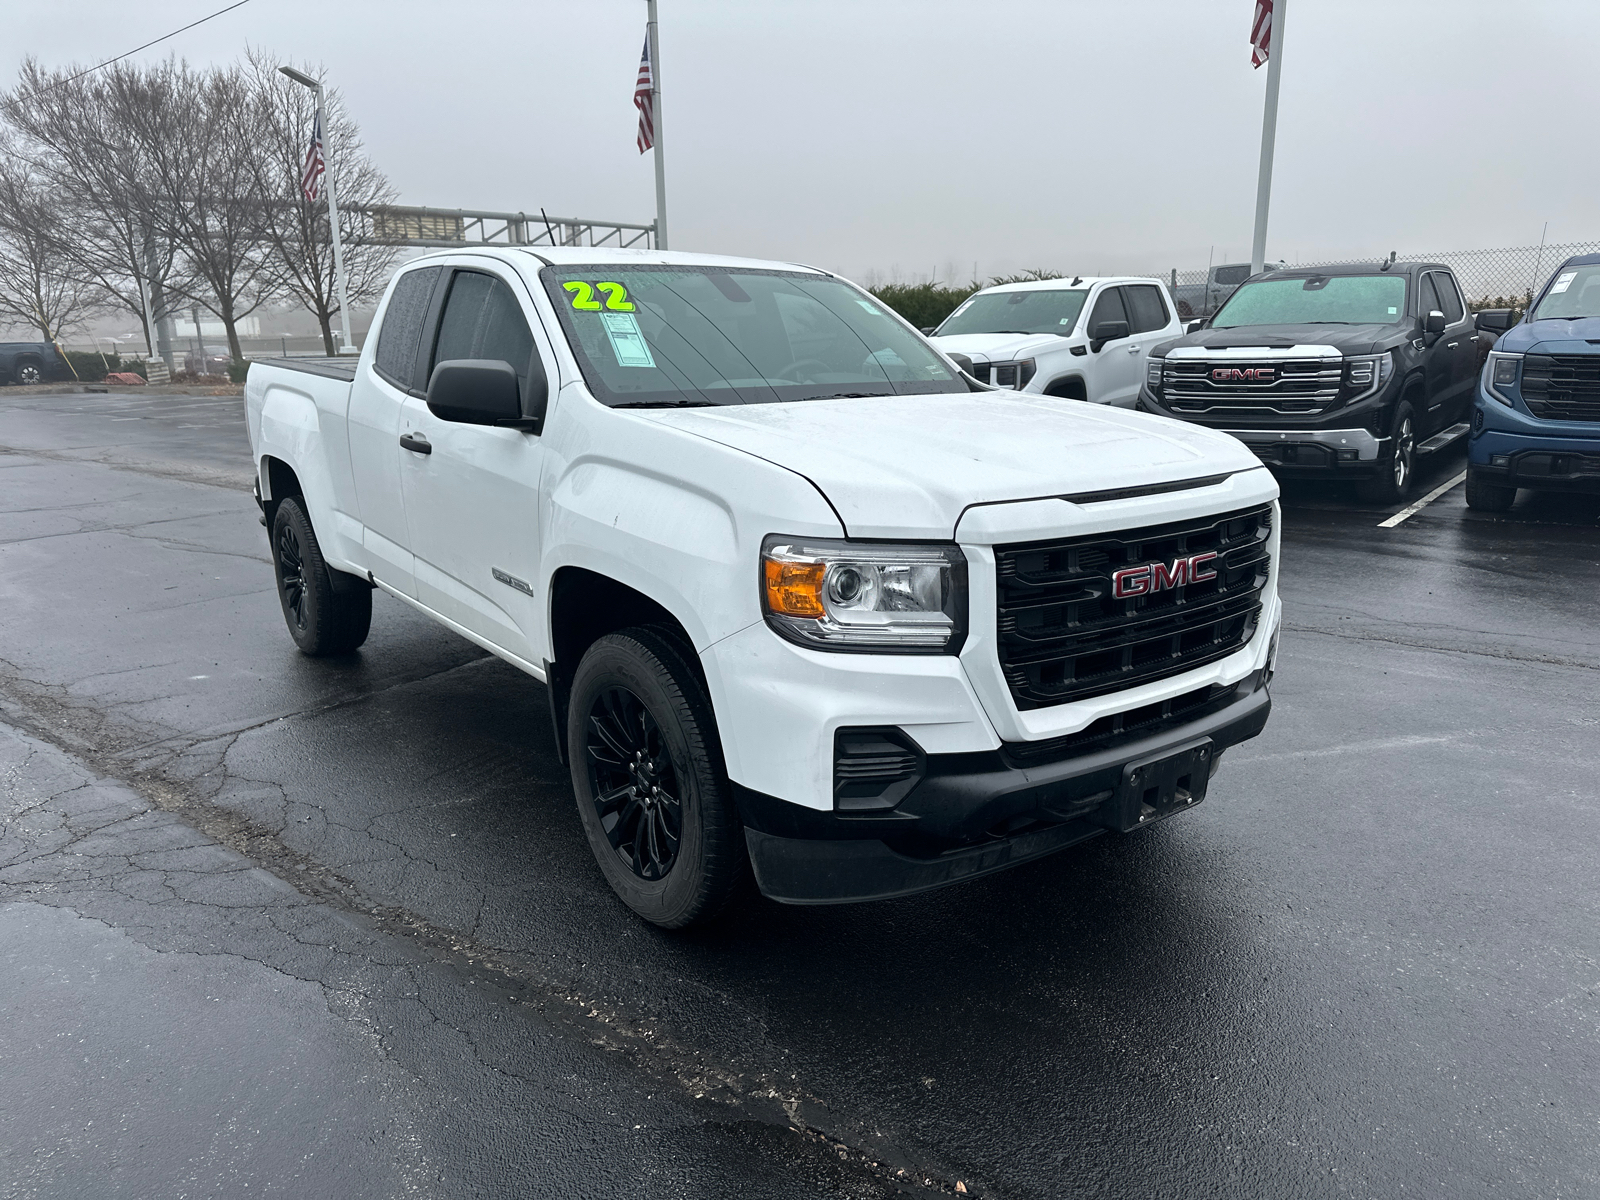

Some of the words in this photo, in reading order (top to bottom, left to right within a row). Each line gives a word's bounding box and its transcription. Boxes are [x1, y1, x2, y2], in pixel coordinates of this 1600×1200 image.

[562, 281, 636, 312] 22
[1212, 368, 1275, 380] GMC
[1112, 551, 1218, 599] GMC
